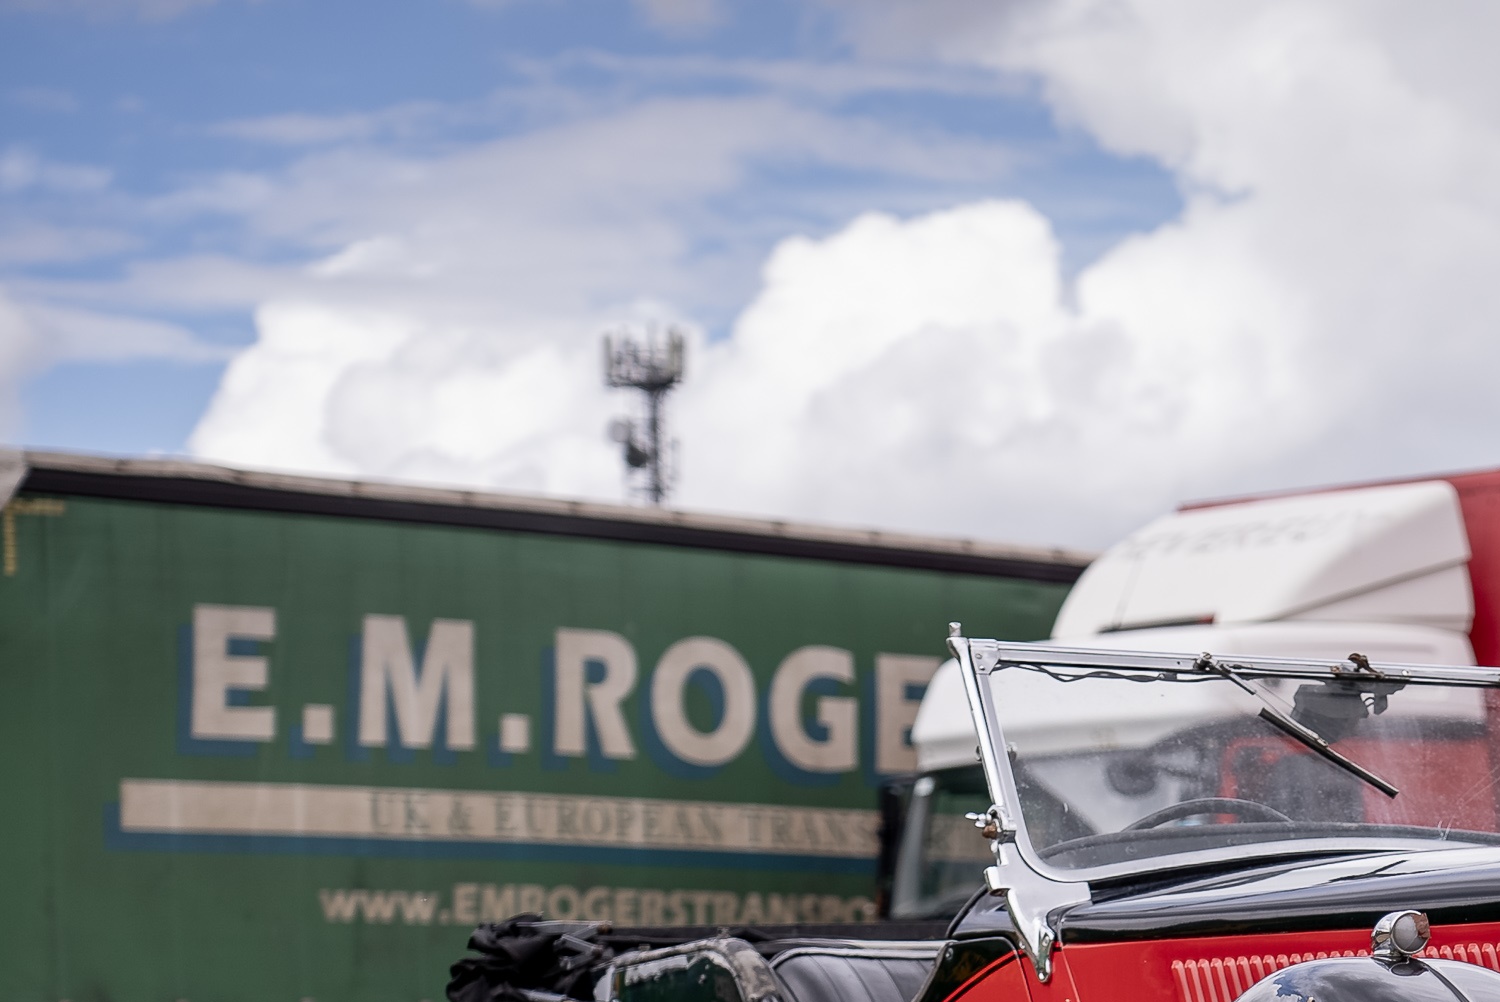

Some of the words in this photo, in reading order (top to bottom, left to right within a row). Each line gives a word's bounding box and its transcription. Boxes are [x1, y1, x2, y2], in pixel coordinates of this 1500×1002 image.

[369, 793, 431, 832] UK
[447, 796, 475, 833] &
[495, 795, 724, 845] EUROPEAN
